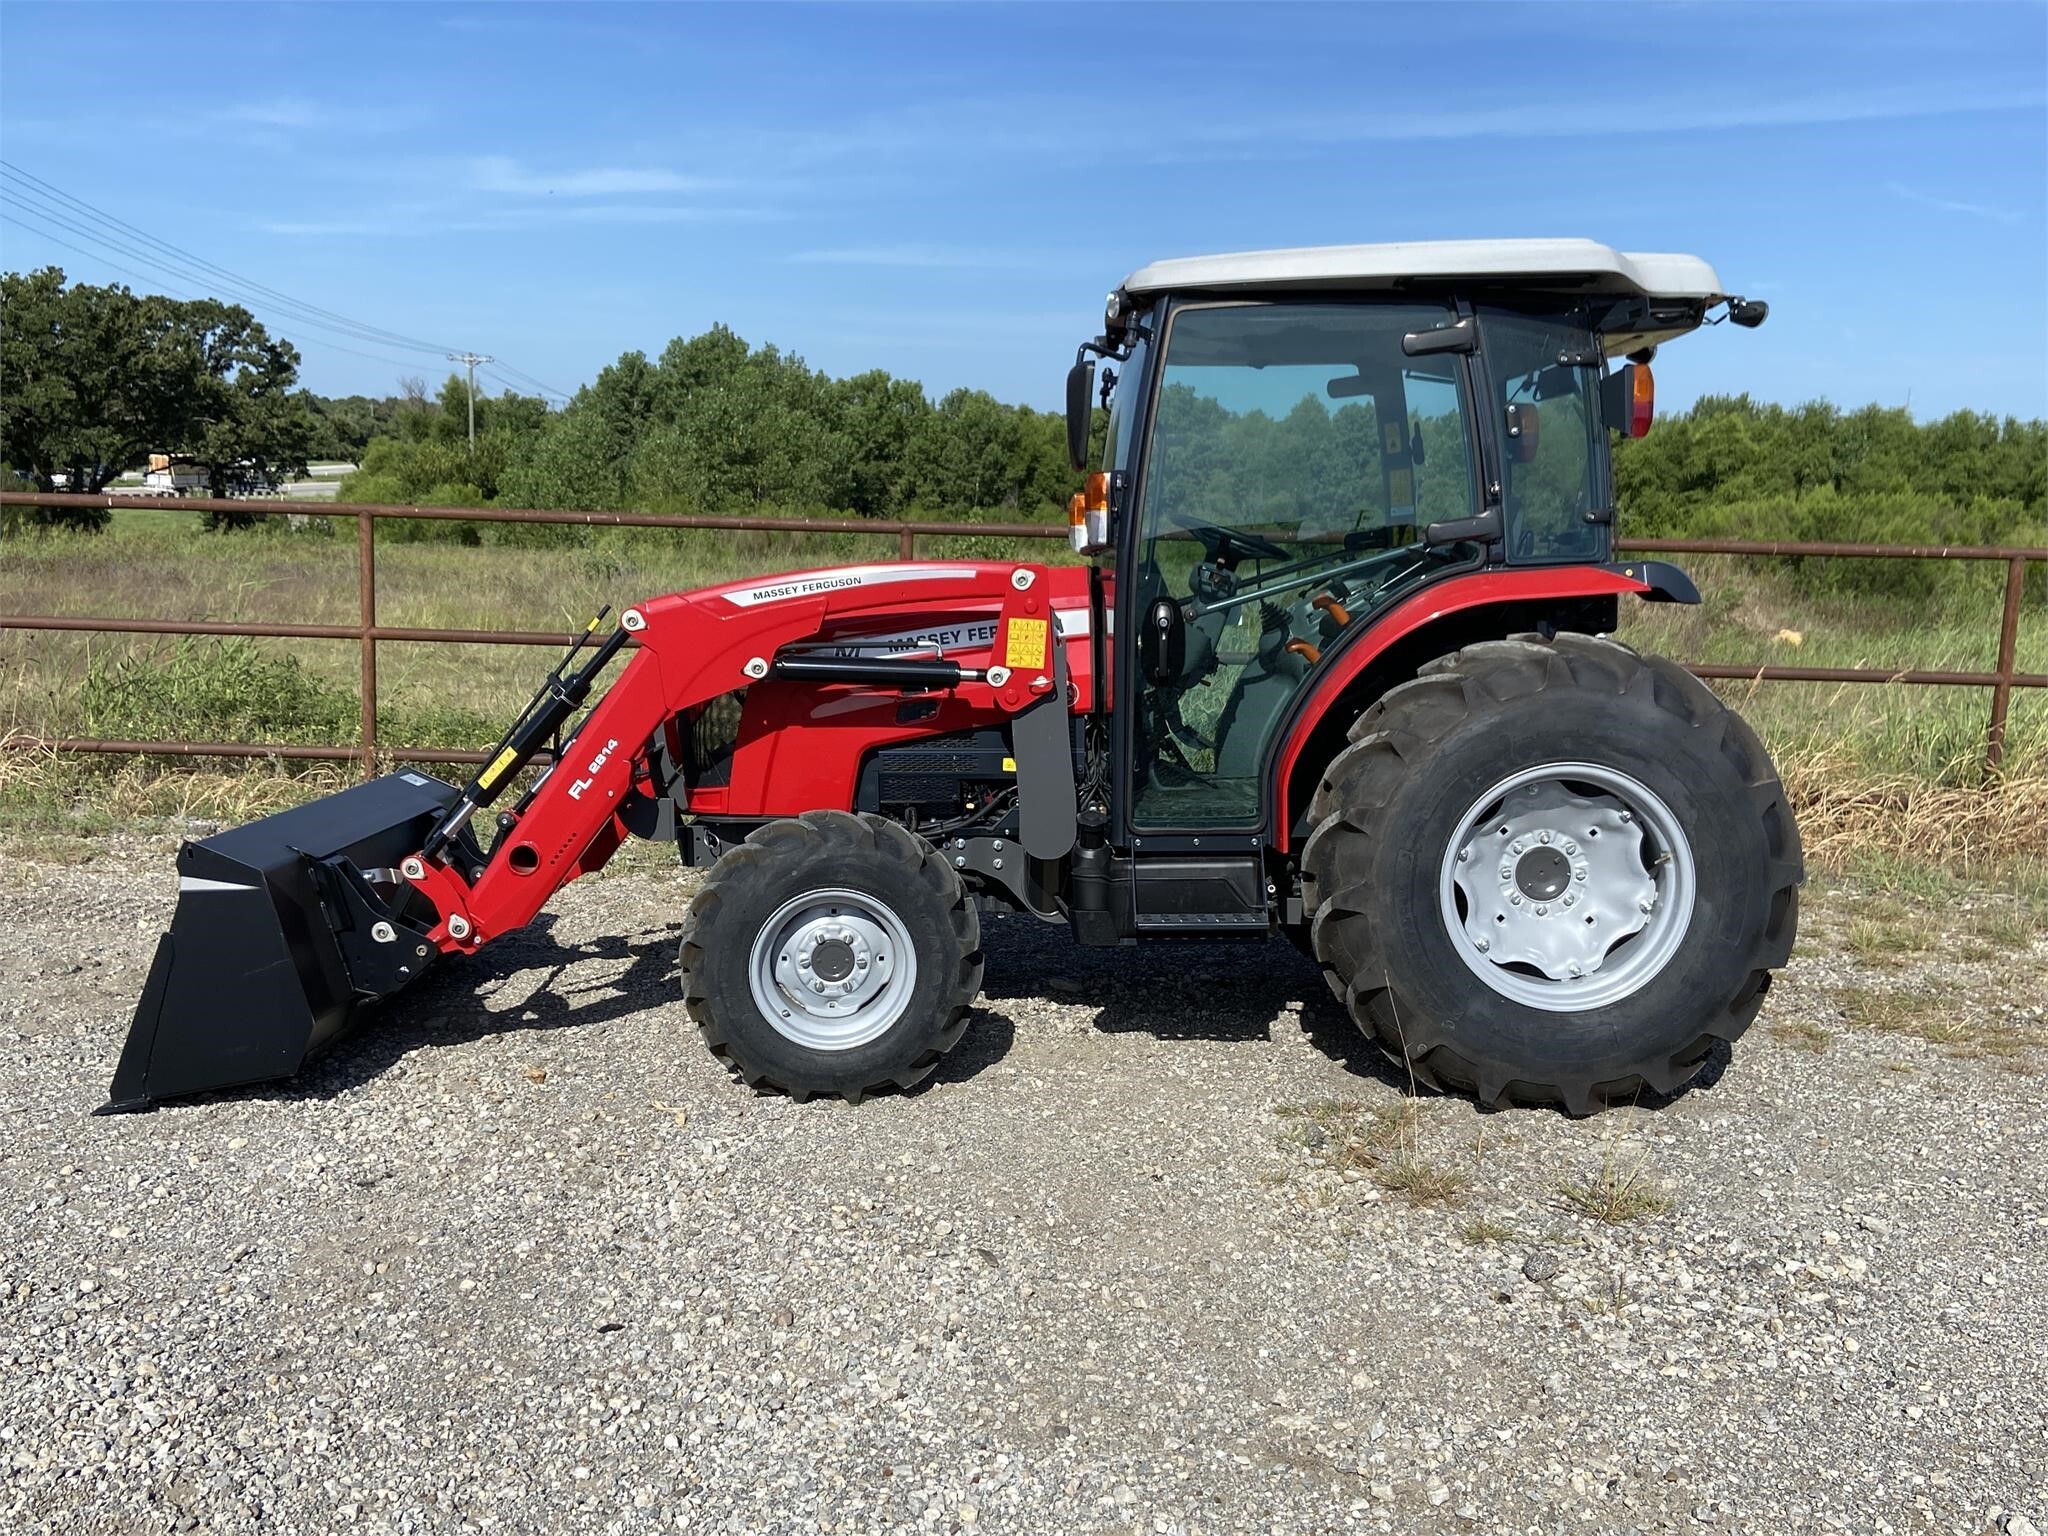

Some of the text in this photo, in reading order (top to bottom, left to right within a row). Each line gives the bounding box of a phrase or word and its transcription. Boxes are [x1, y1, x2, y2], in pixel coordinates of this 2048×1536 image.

[753, 577, 862, 600] MASSEY FERGUSON
[567, 738, 618, 801] FL 2814
